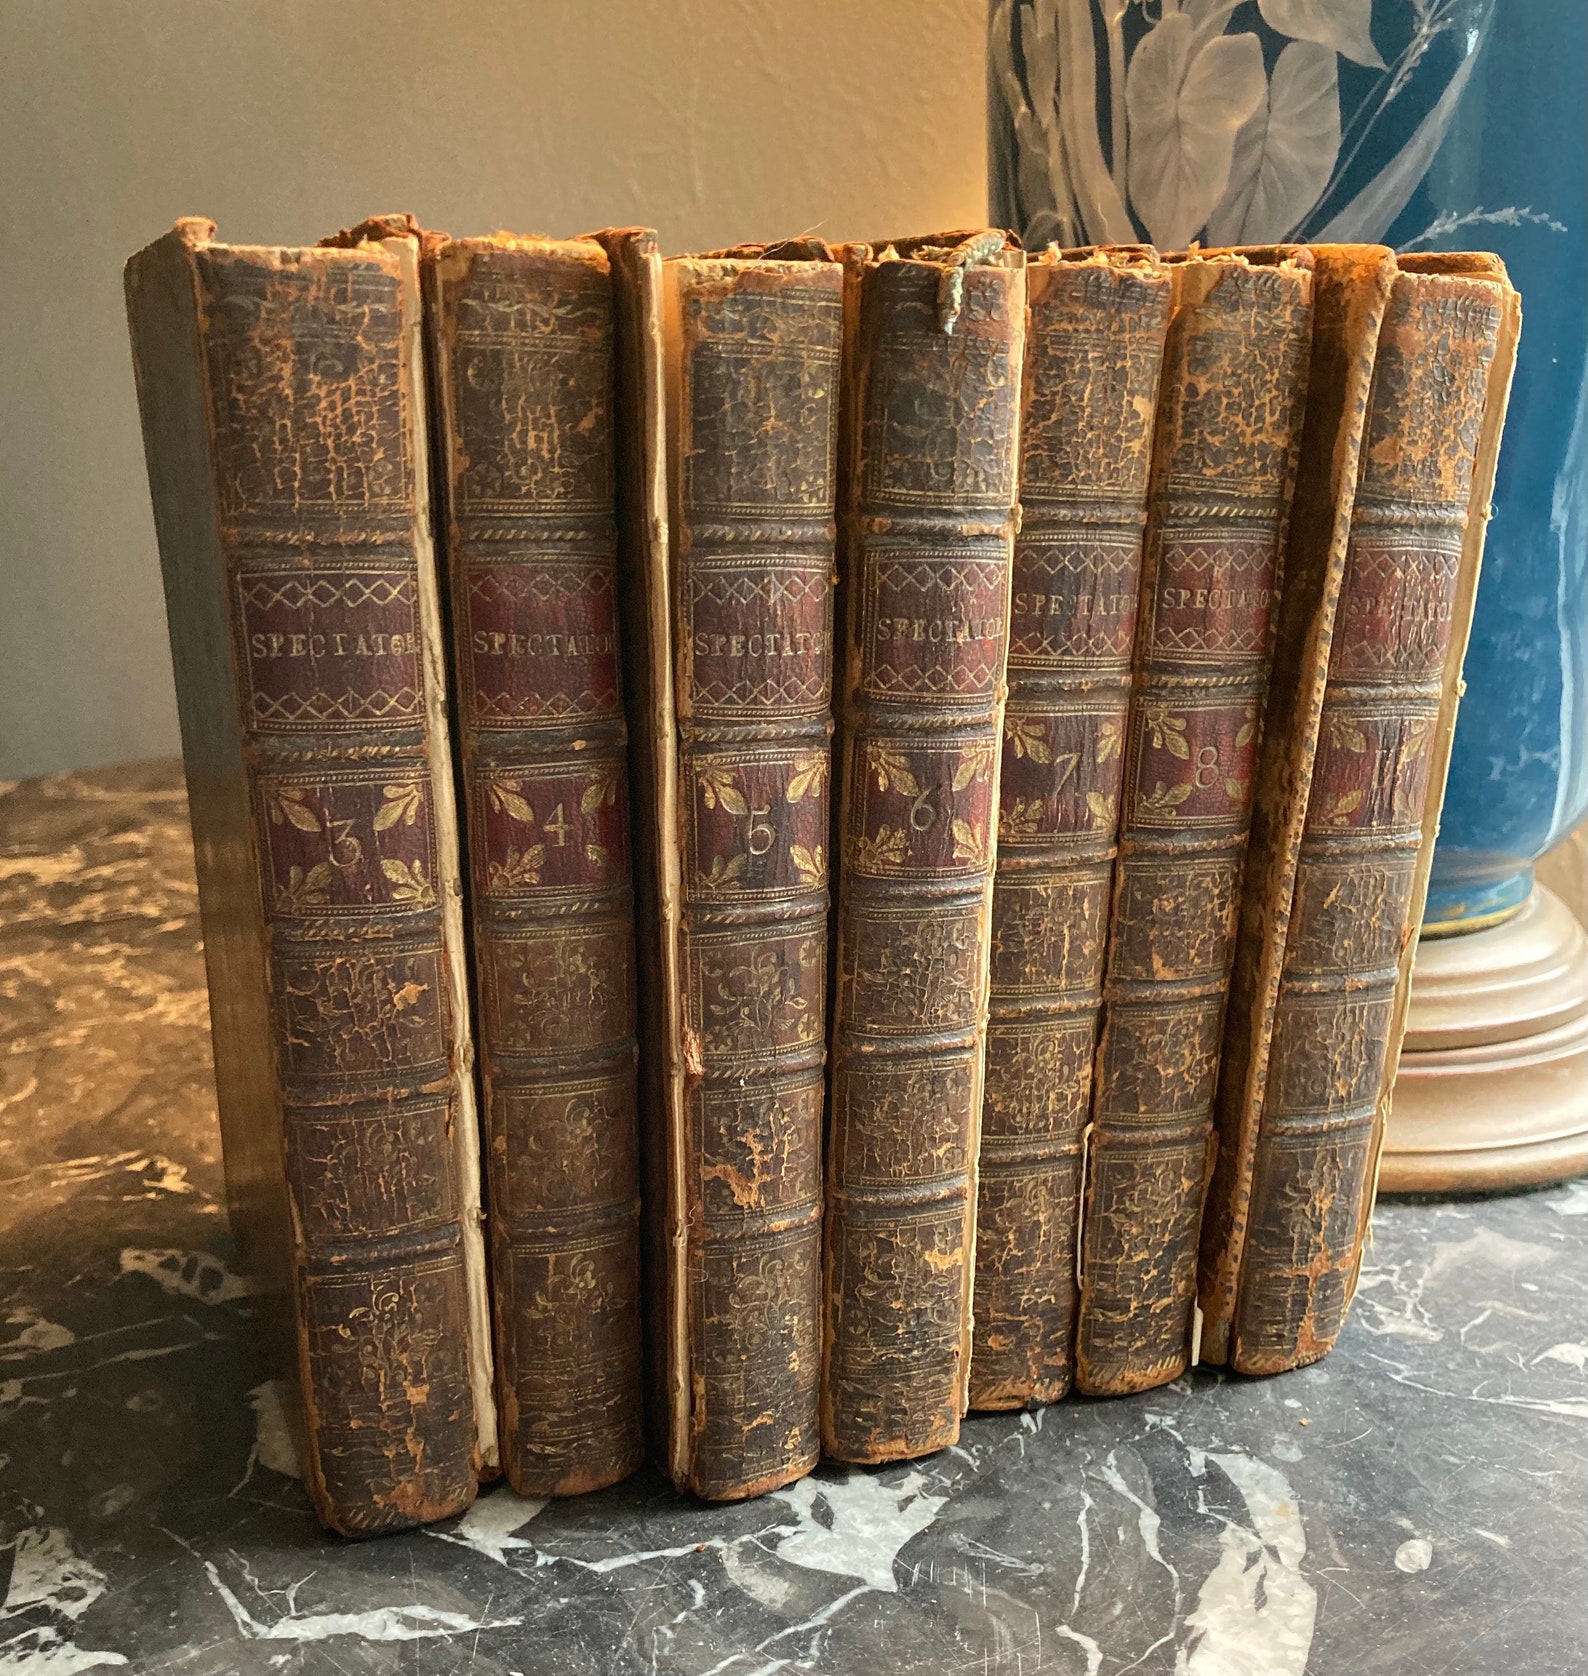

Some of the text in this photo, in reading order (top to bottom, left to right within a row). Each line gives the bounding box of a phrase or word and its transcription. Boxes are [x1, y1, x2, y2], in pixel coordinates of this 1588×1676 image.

[252, 632, 420, 659] SPECTATOR
[1054, 752, 1082, 798] 7
[1196, 746, 1220, 788] 8
[542, 802, 573, 847] 4
[749, 803, 776, 855] 5
[910, 784, 942, 832] 6
[329, 817, 362, 868] 3
